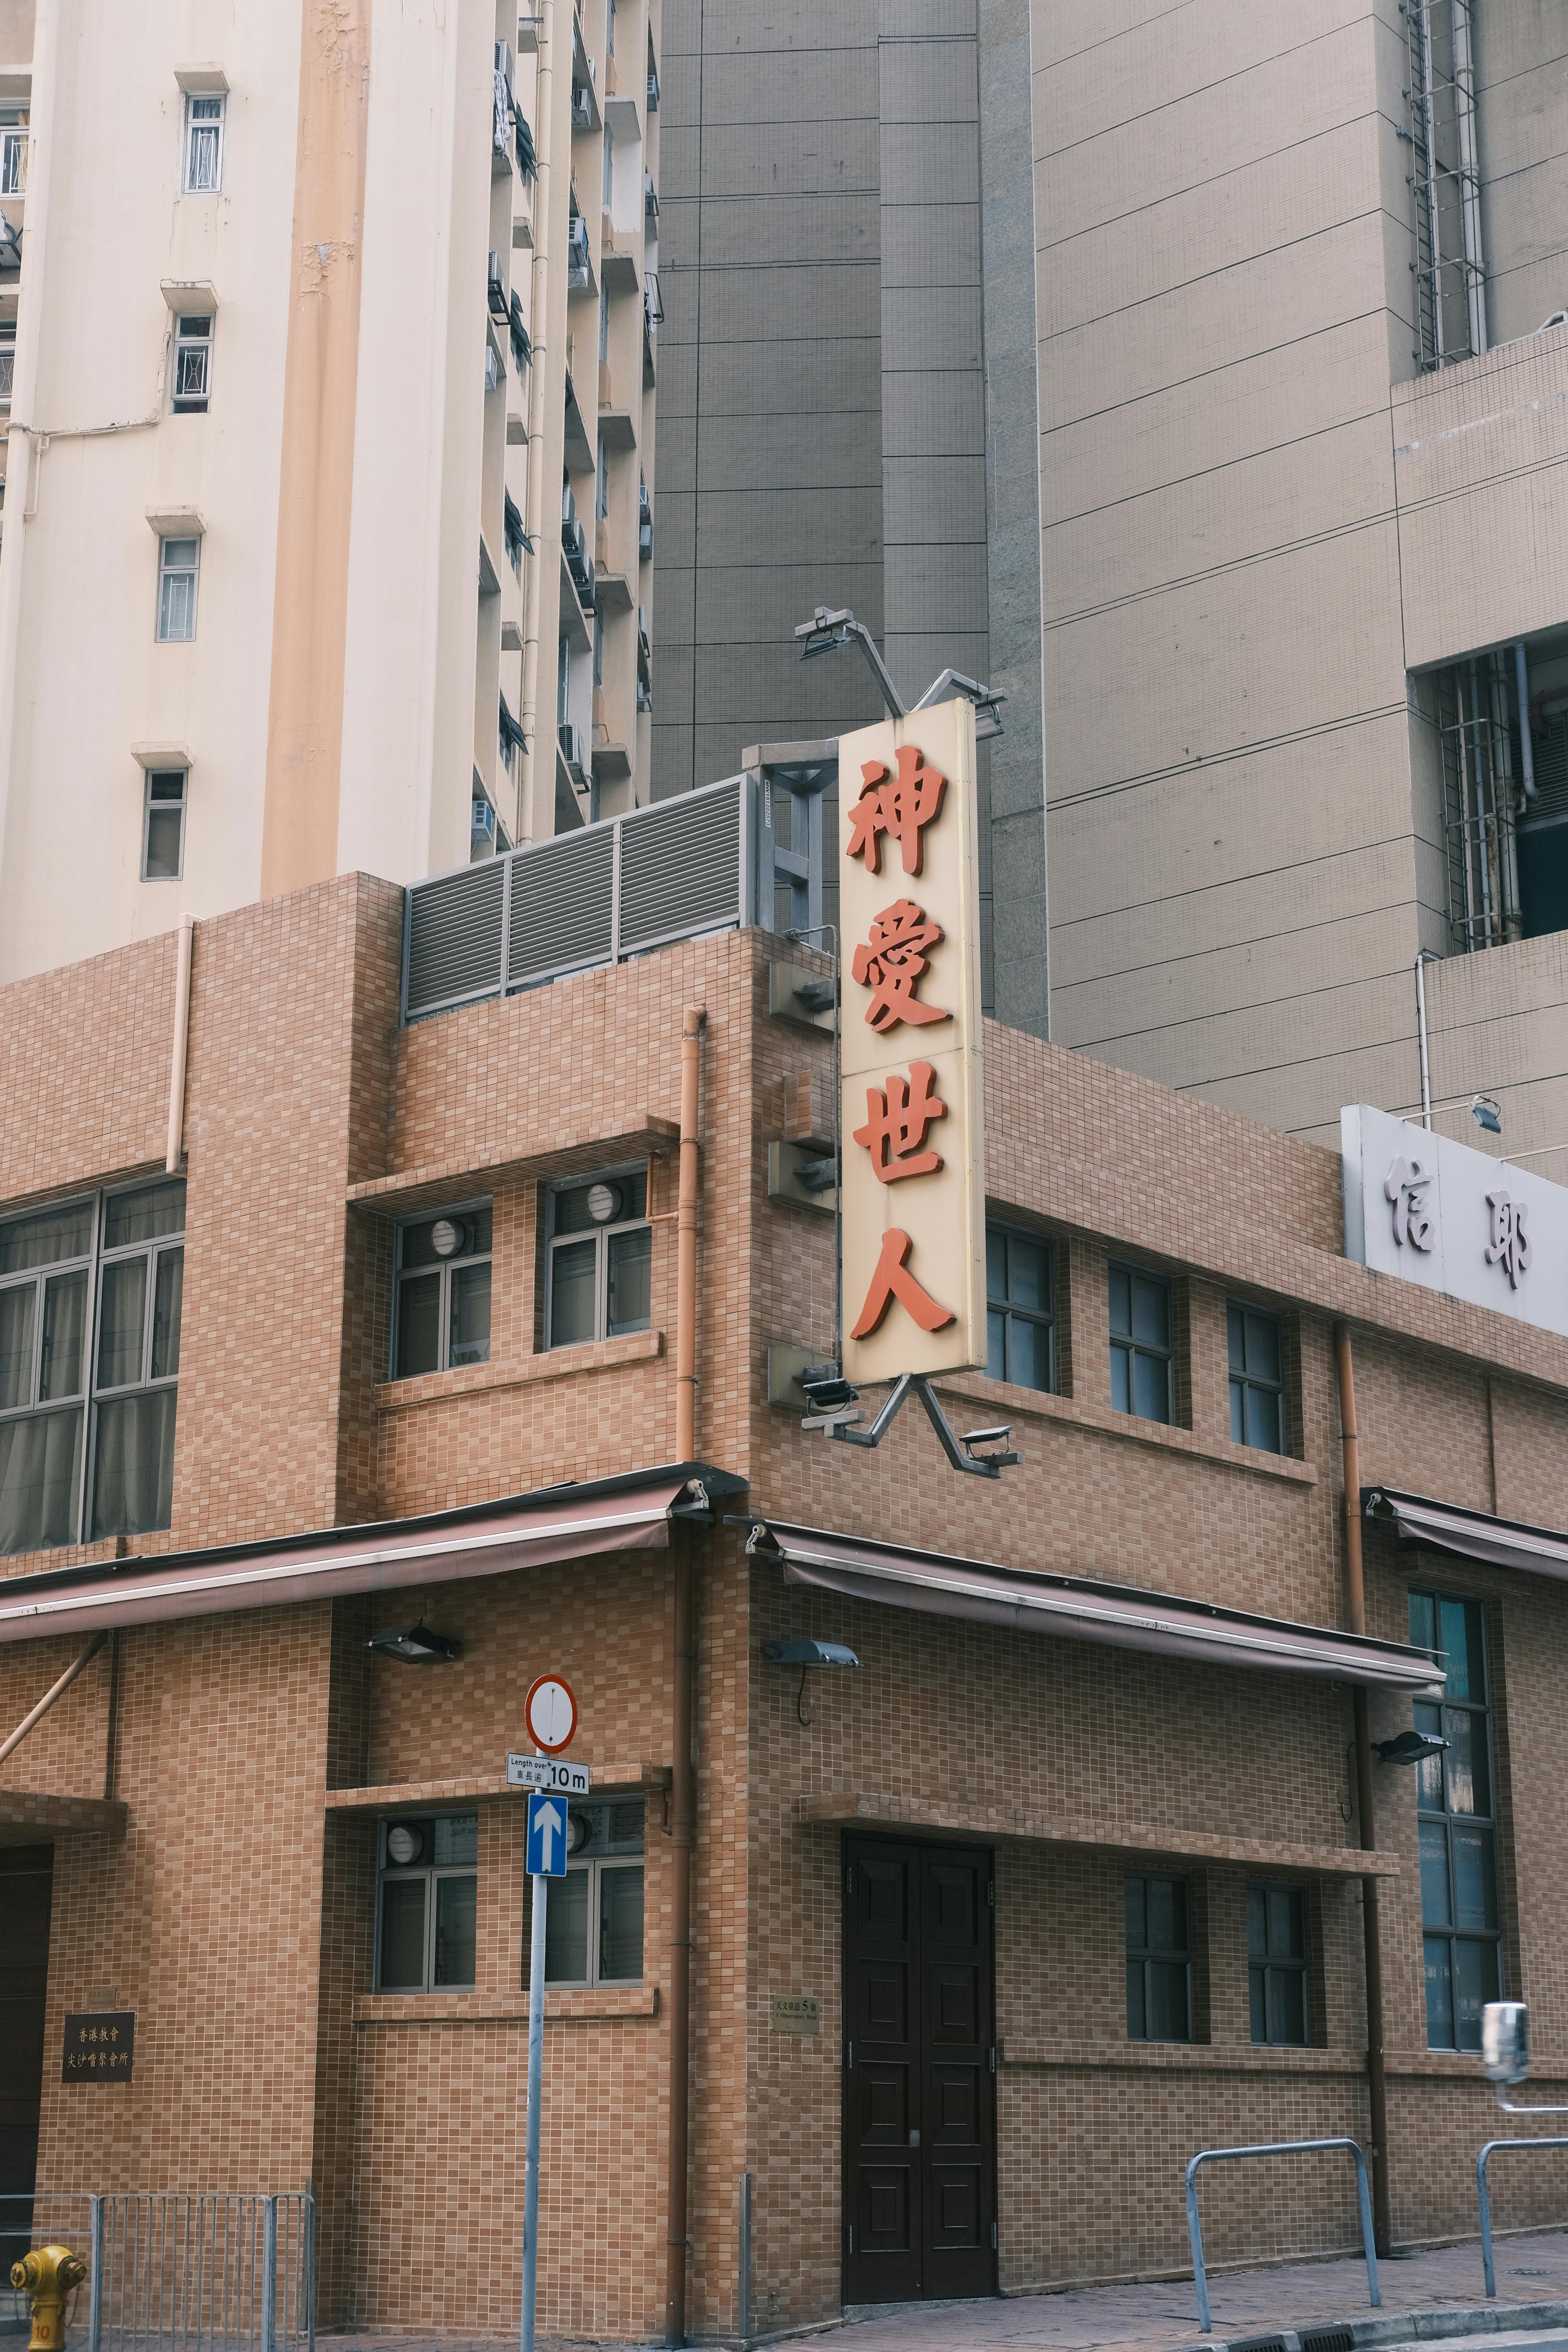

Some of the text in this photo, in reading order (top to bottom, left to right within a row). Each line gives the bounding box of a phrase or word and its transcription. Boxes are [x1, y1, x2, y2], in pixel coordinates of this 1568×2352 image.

[847, 744, 957, 1341] 神愛世人
[511, 1758, 533, 1768] Length
[516, 1770, 542, 1782] 車長逾
[79, 2026, 119, 2043] 香港教會
